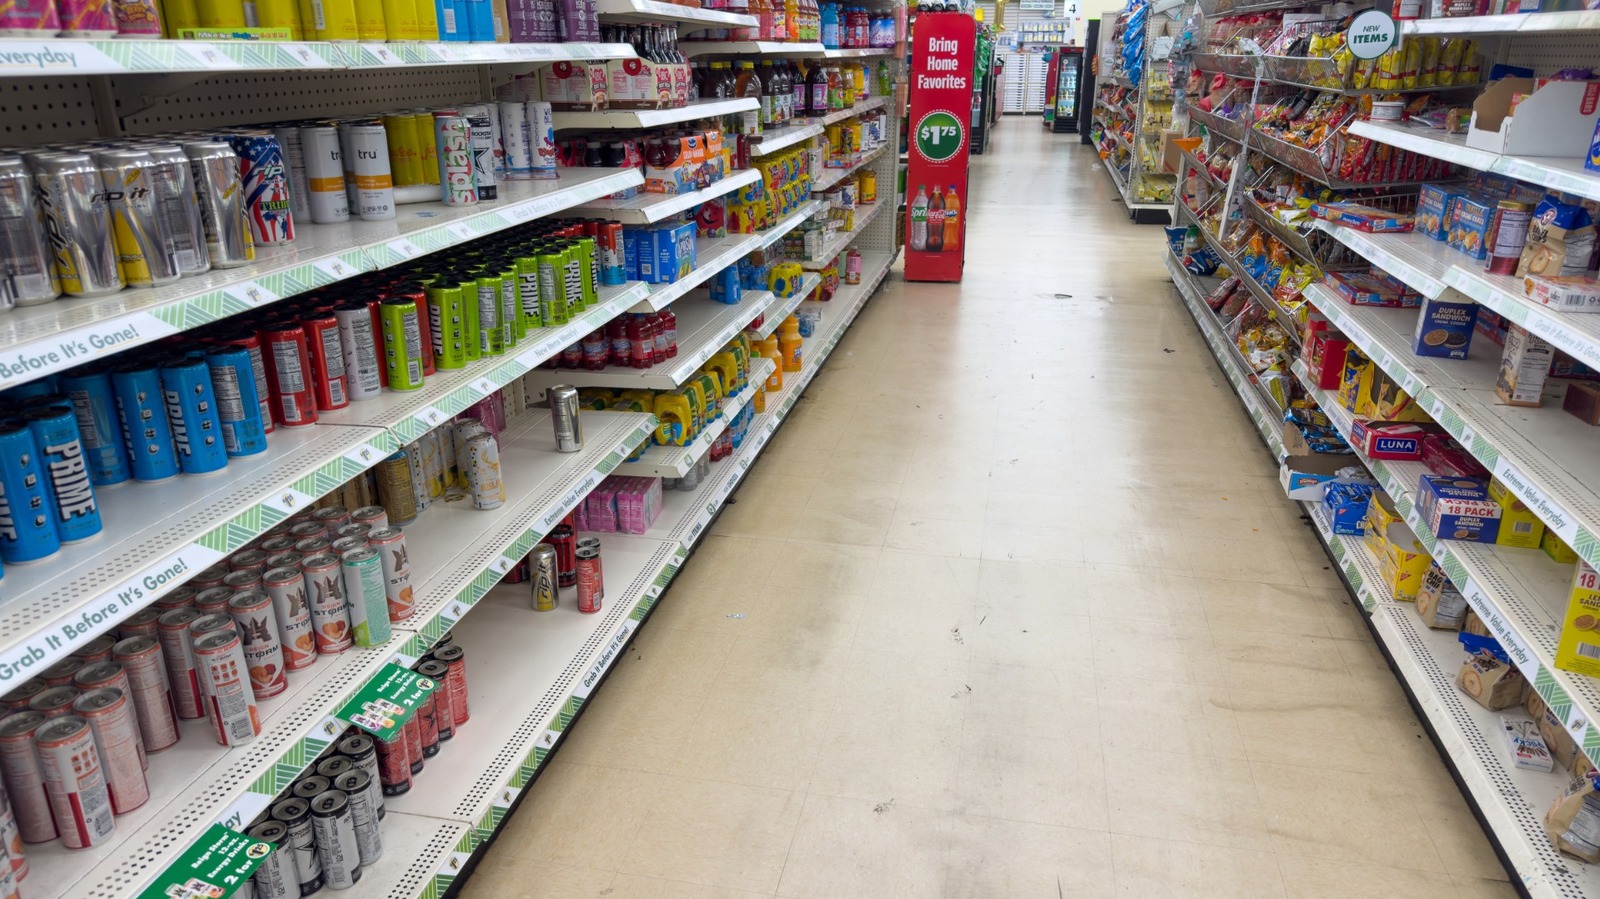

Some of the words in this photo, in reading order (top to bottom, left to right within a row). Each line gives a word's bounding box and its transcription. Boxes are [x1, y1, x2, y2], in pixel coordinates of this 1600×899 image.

[1068, 4, 1077, 14] 4
[928, 37, 958, 55] Bring
[1353, 33, 1388, 44] ITEMS
[0, 46, 77, 68] veryday
[927, 56, 958, 71] Home
[918, 74, 966, 89] Favorites
[358, 149, 377, 160] tru
[130, 187, 149, 199] it
[519, 273, 540, 318] PRIME
[1431, 313, 1471, 322] SANDWICH
[1438, 307, 1467, 315] DUPLEX
[60, 341, 88, 359] It's
[89, 323, 140, 349] Gone!
[1381, 440, 1412, 449] LUNA
[43, 437, 96, 522] PRIME
[544, 506, 564, 526] Extreme
[562, 493, 577, 507] Value
[574, 477, 595, 497] Everyday
[1502, 468, 1525, 492] Extreme
[1523, 487, 1540, 505] Value
[1538, 501, 1567, 530] Everyday
[1448, 506, 1461, 514] 18
[1465, 507, 1495, 517] PACK
[539, 575, 551, 599] rip
[1580, 573, 1595, 588] 18
[0, 645, 46, 682] Grab
[45, 634, 62, 651] It
[61, 604, 119, 641] Before
[117, 587, 143, 607] It's
[143, 557, 189, 590] Gone!
[1471, 592, 1491, 618] Extreme
[1490, 614, 1505, 634] Value
[1503, 632, 1530, 664] Everyday
[584, 671, 597, 688] Grab
[594, 665, 601, 674] It
[598, 650, 613, 669] Before
[610, 641, 619, 651] It's
[616, 626, 630, 643] Gone!
[390, 685, 407, 699] Energy
[403, 699, 414, 707] 2
[411, 690, 423, 699] for
[218, 837, 240, 854] 12-oz.
[191, 851, 212, 869] Reign
[207, 857, 231, 878] Energy
[228, 839, 250, 858] Drinks
[224, 874, 239, 885] 2
[235, 860, 253, 874] for
